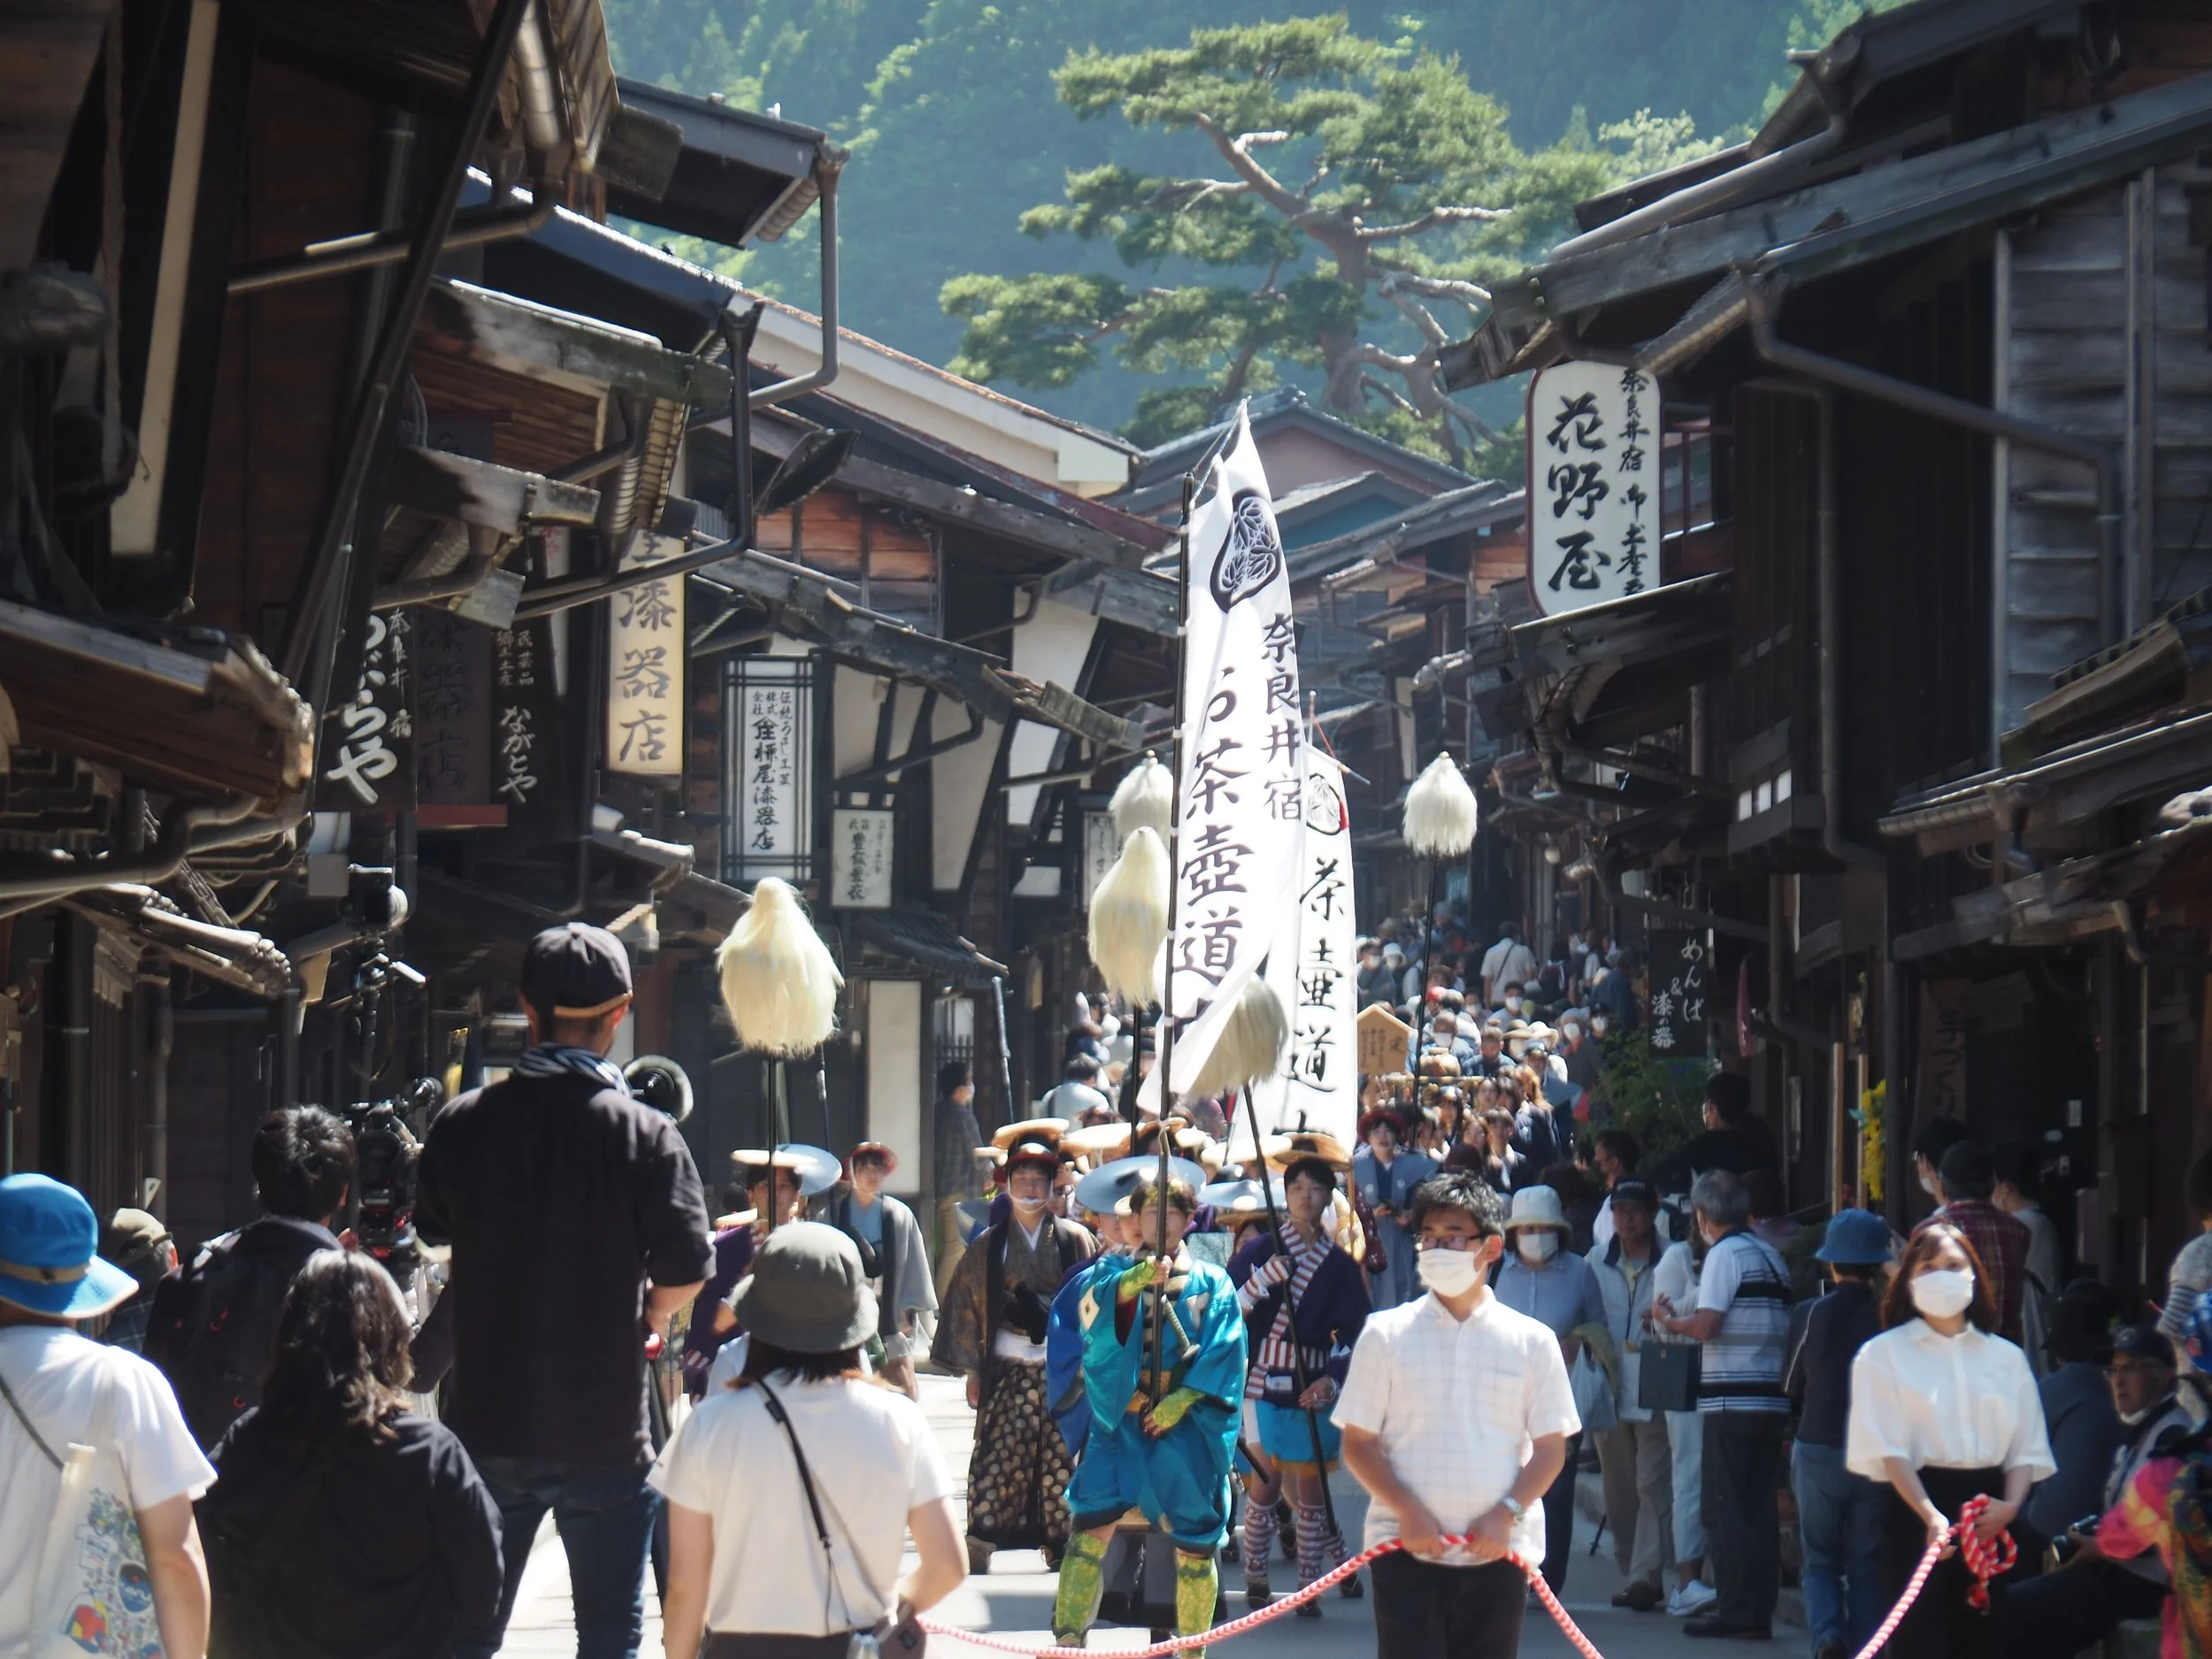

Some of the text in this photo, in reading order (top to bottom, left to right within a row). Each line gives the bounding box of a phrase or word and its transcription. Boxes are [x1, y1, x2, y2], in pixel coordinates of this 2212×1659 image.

[1618, 366, 1650, 472] 奈良井宿
[1547, 391, 1611, 592] 花野屋
[388, 606, 412, 739] 奈良井宿
[1261, 612, 1302, 821] 奈良井宿
[498, 705, 538, 803] ながとや
[1651, 989, 1677, 1049] 漆の器
[1671, 976, 1684, 997] &
[1680, 936, 1704, 1024] めんば
